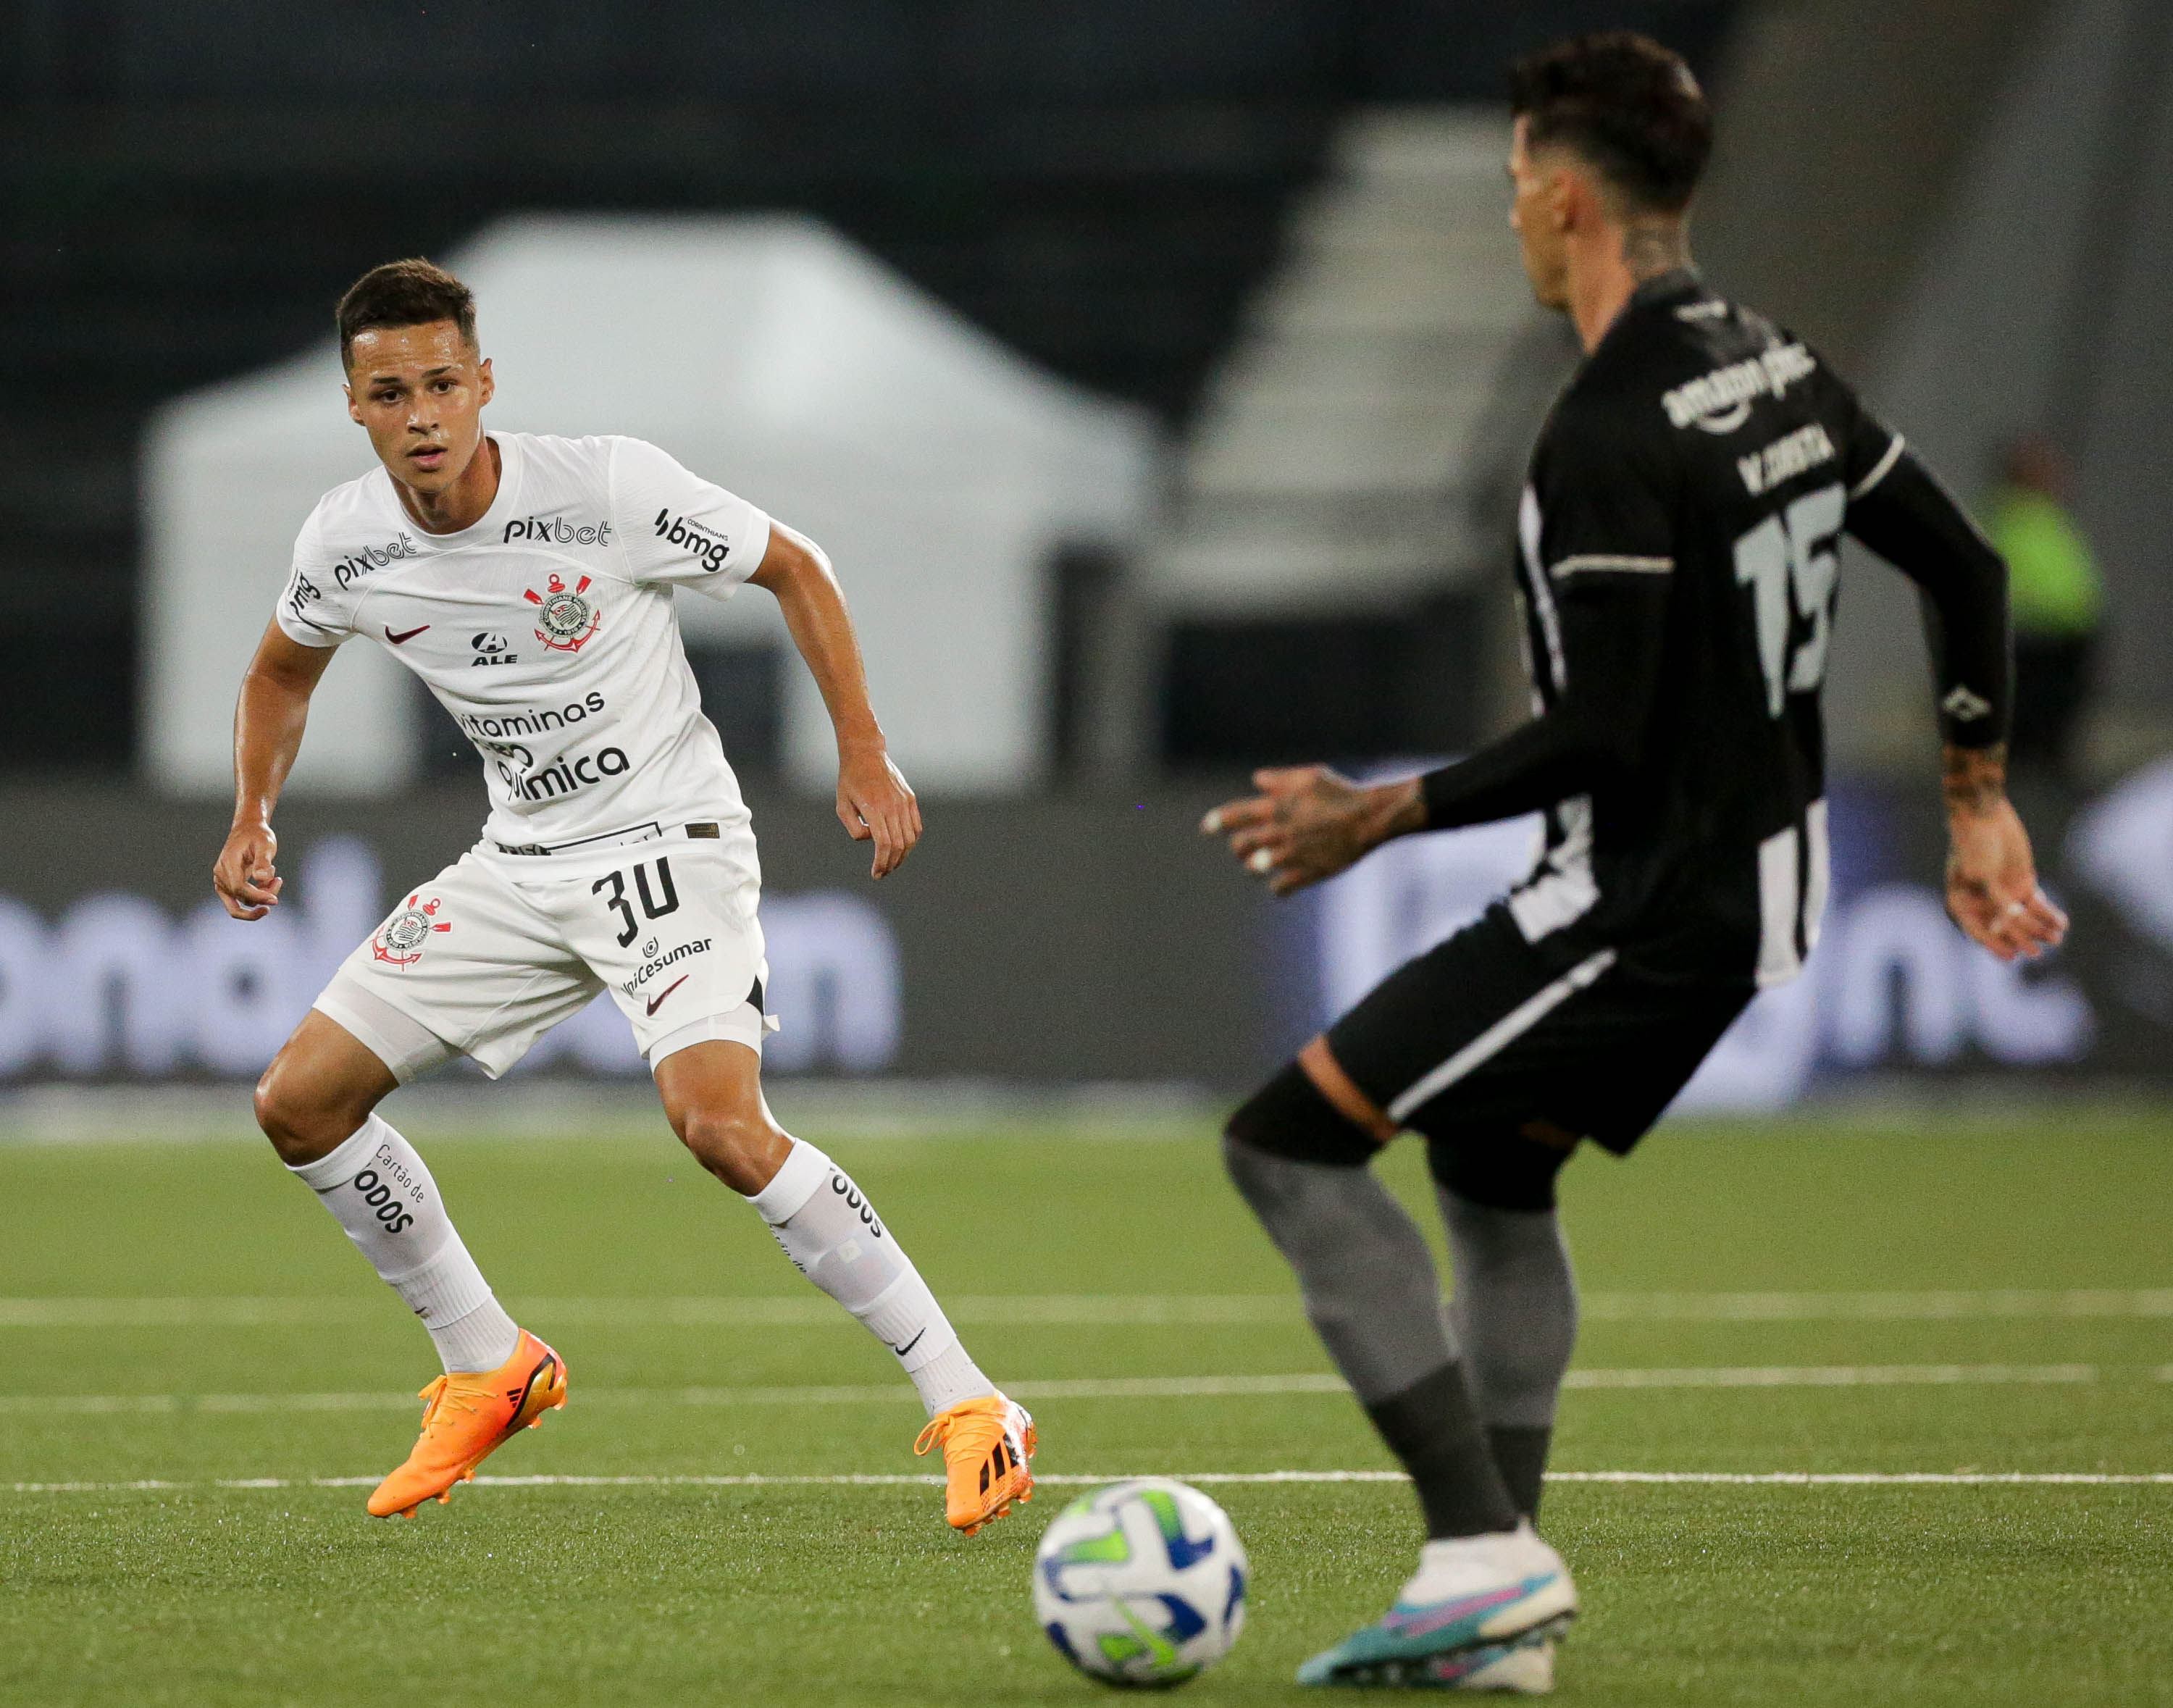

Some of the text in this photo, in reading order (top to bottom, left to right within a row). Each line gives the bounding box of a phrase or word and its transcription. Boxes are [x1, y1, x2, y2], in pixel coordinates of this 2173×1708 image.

[503, 516, 612, 547] pixbet
[666, 516, 729, 572] bmg
[687, 519, 729, 541] CORINTHIANS
[335, 532, 417, 591] pixbet
[1733, 483, 1848, 719] 15
[471, 654, 518, 666] ALE
[592, 856, 679, 948] 30
[354, 1162, 414, 1234] ODOS
[376, 1144, 424, 1203] Cartão de
